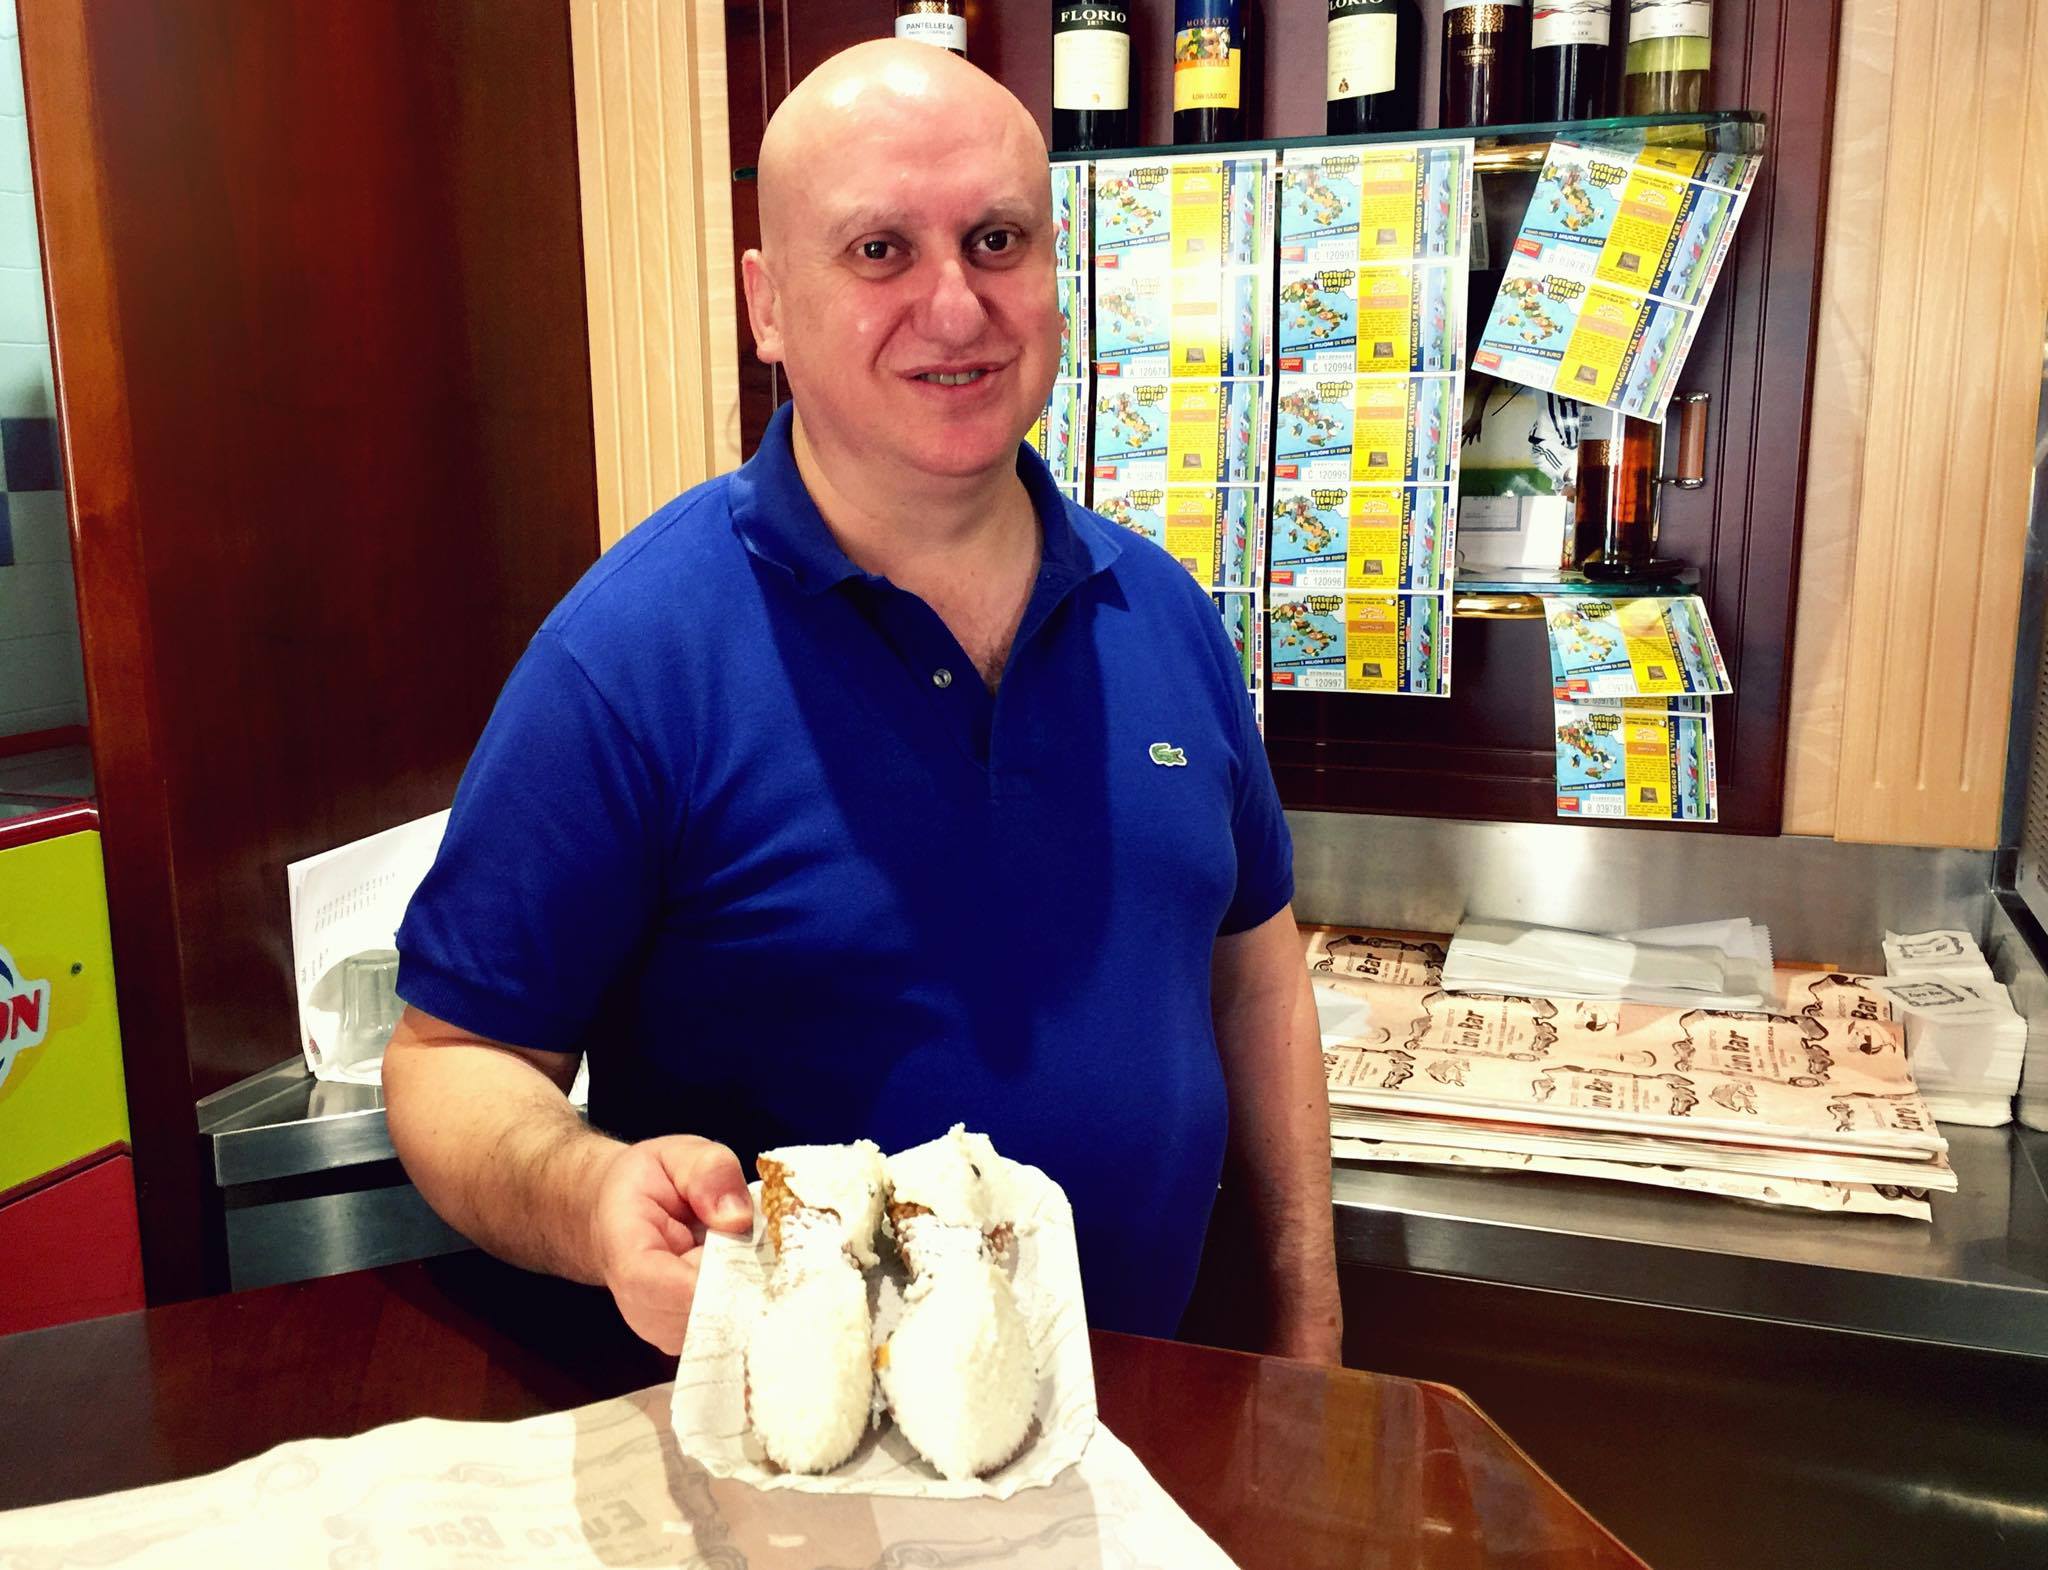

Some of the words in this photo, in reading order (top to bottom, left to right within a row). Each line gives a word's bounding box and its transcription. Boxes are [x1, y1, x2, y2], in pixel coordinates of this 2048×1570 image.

[1060, 9, 1127, 23] FLORIO
[1186, 17, 1229, 27] MOSCATO
[1588, 160, 1627, 178] Lotteria
[1589, 170, 1621, 186] Italia
[1656, 242, 1675, 279] VIAGGIO
[1318, 269, 1355, 279] Lotteria
[1546, 275, 1585, 293] Lotteria
[1548, 284, 1580, 300] Italia
[1323, 362, 1352, 372] 120994
[1311, 489, 1347, 497] Lotteria
[1307, 595, 1343, 604] Lotteria
[1314, 678, 1342, 688] 120997
[1589, 714, 1621, 723] Lotteria
[1356, 953, 1382, 975] Bar
[1851, 996, 1879, 1021] Bar
[1457, 1009, 1484, 1031] Bar
[1722, 1029, 1751, 1053] Bar
